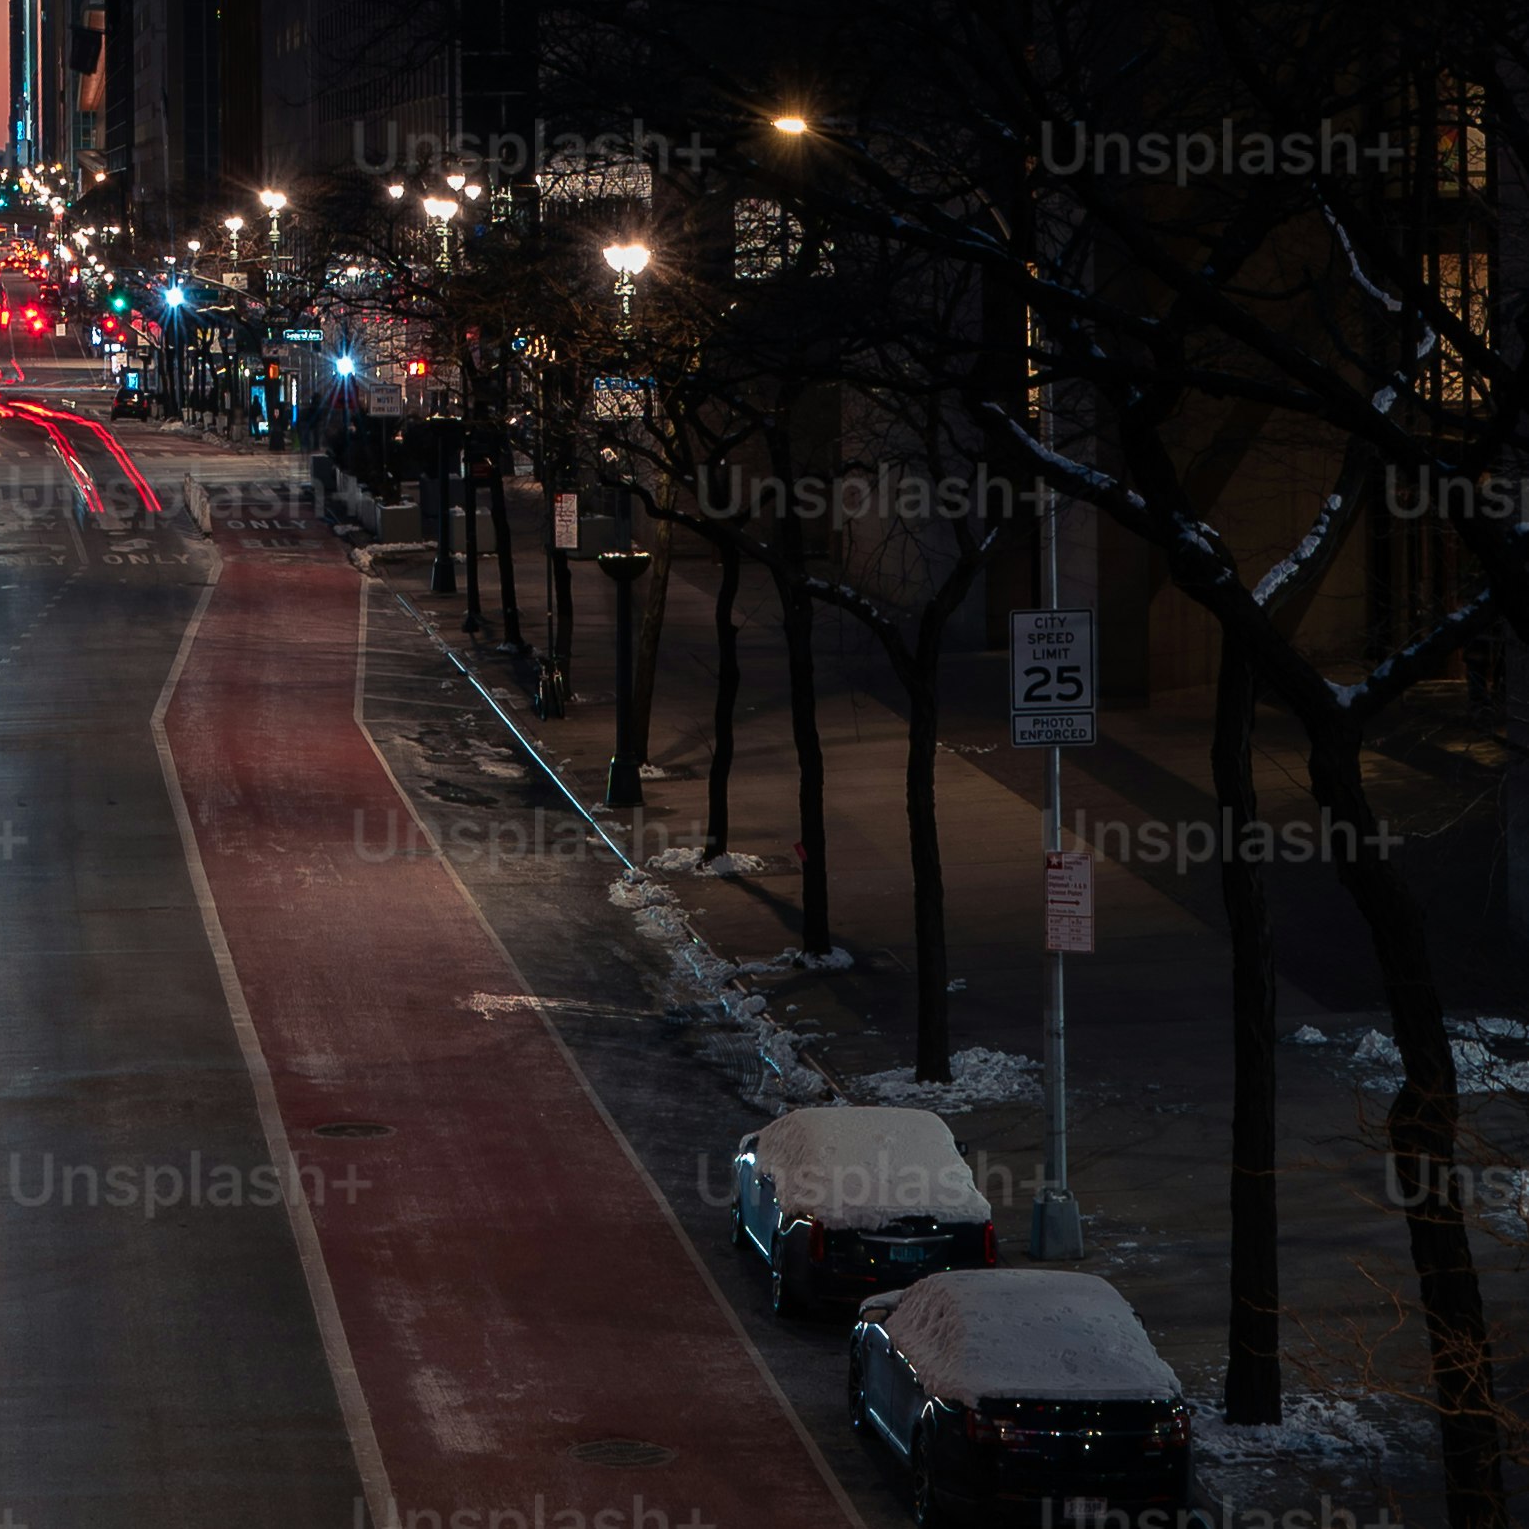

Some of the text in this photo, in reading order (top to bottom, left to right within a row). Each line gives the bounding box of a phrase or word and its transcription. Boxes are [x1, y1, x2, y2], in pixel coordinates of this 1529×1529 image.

[227, 519, 307, 530] ONLY
[102, 553, 191, 565] ONLY
[1034, 616, 1067, 629] CITY
[1027, 632, 1075, 644] SPEED
[1033, 648, 1070, 660] LIMIT
[1023, 665, 1084, 702] 25
[1033, 717, 1074, 728] PHOTO
[1020, 728, 1087, 740] ENFORCED
